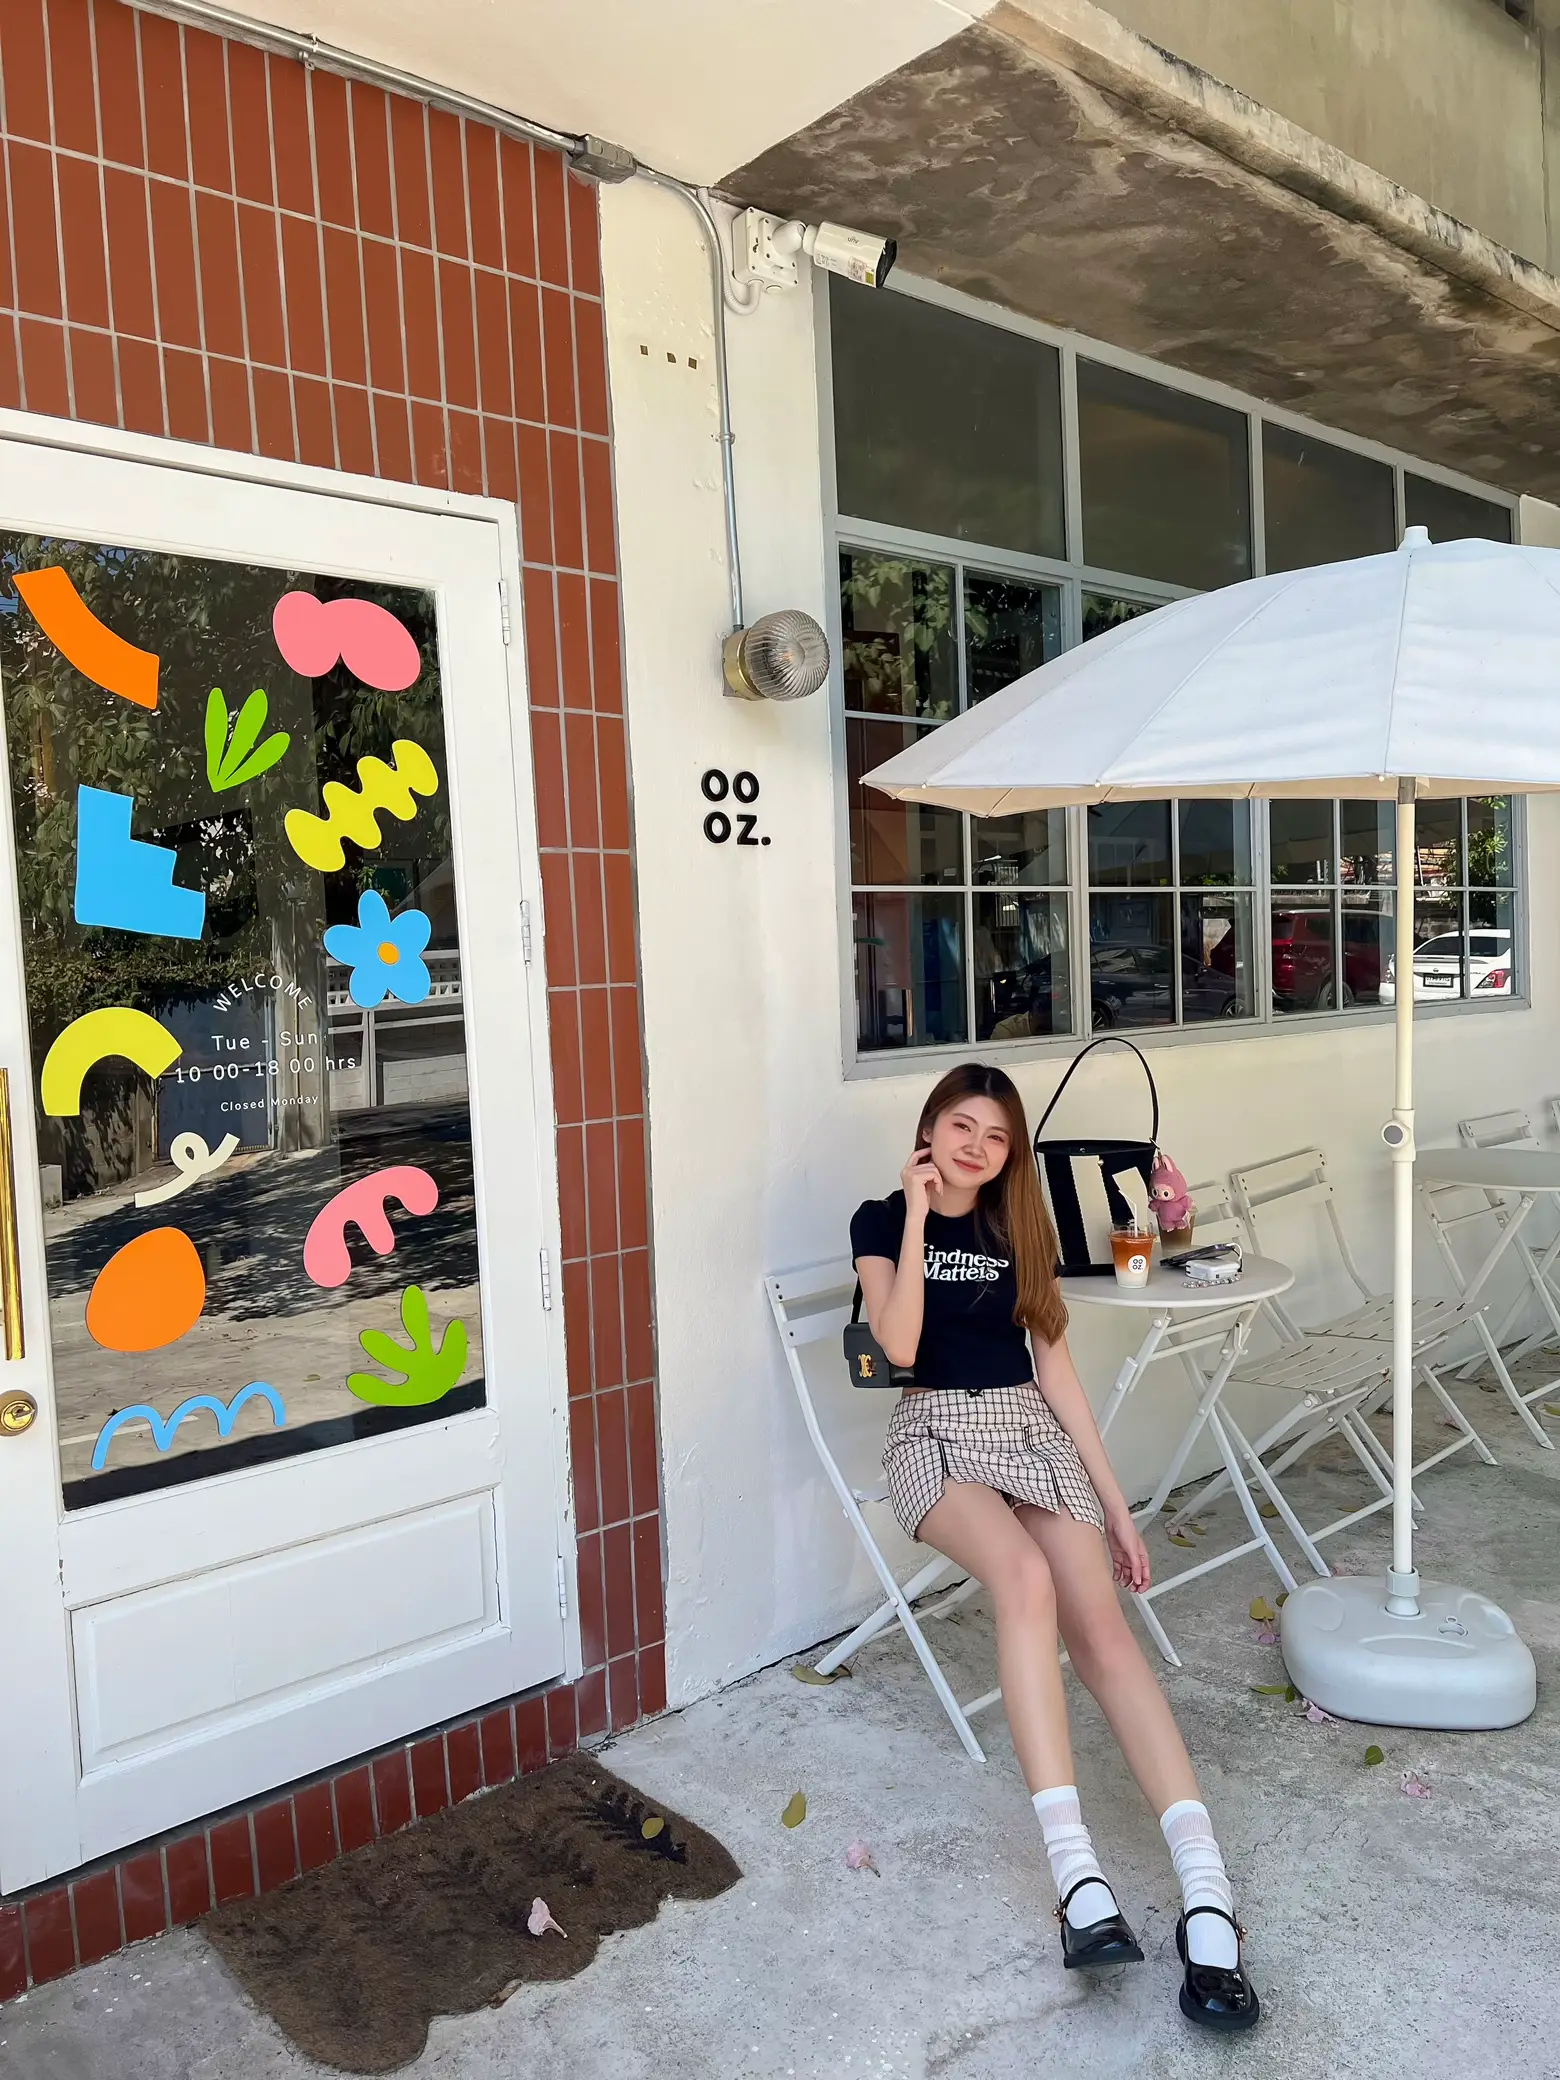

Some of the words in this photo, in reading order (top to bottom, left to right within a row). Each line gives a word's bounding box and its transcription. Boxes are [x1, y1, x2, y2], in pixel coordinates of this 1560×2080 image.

[212, 973, 313, 1012] WELCOME
[211, 1035, 250, 1051] Tue
[280, 1031, 318, 1046] Sun
[325, 1056, 356, 1071] hrs
[220, 1098, 265, 1112] Closed
[270, 1095, 318, 1108] Monday
[923, 1243, 1010, 1268] indness
